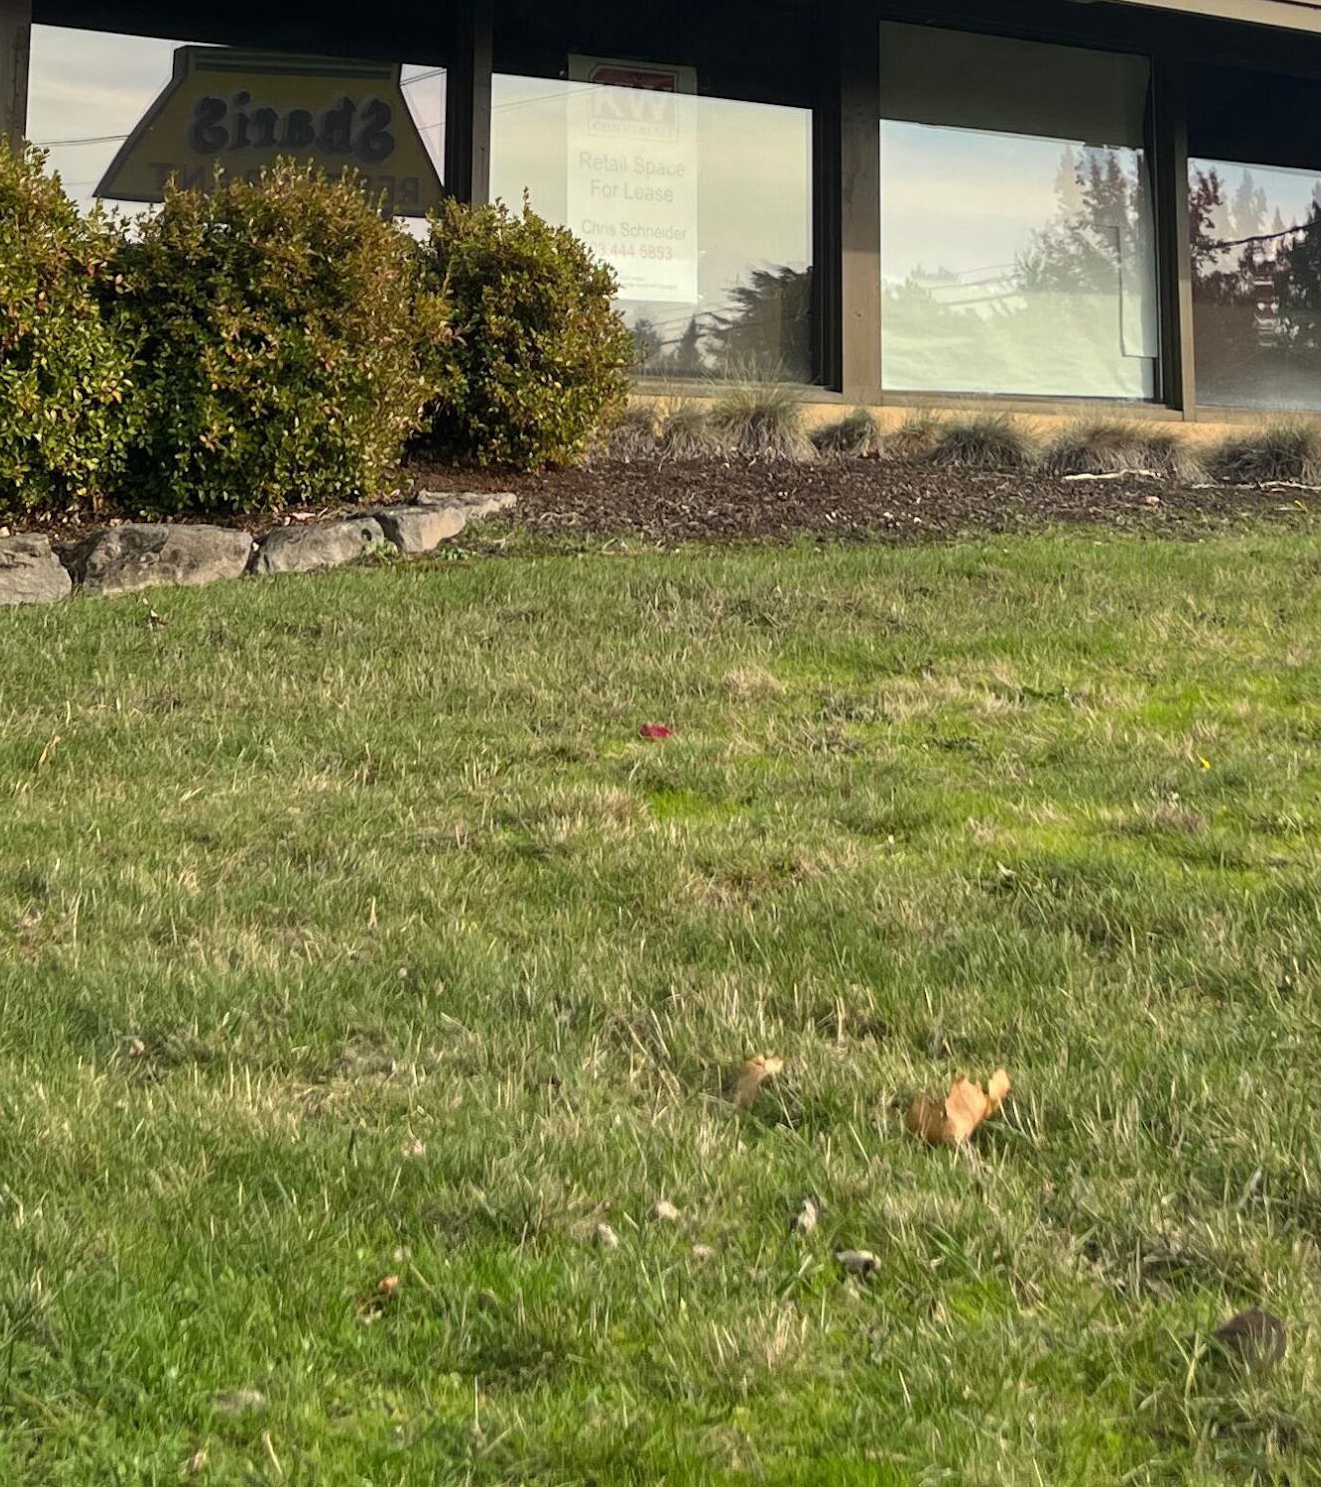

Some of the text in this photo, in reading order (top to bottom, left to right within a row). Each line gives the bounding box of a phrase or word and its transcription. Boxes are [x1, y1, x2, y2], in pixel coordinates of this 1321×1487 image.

[580, 152, 686, 178] Retail Space
[590, 178, 674, 203] For Lease
[581, 218, 686, 241] Chris Schneider
